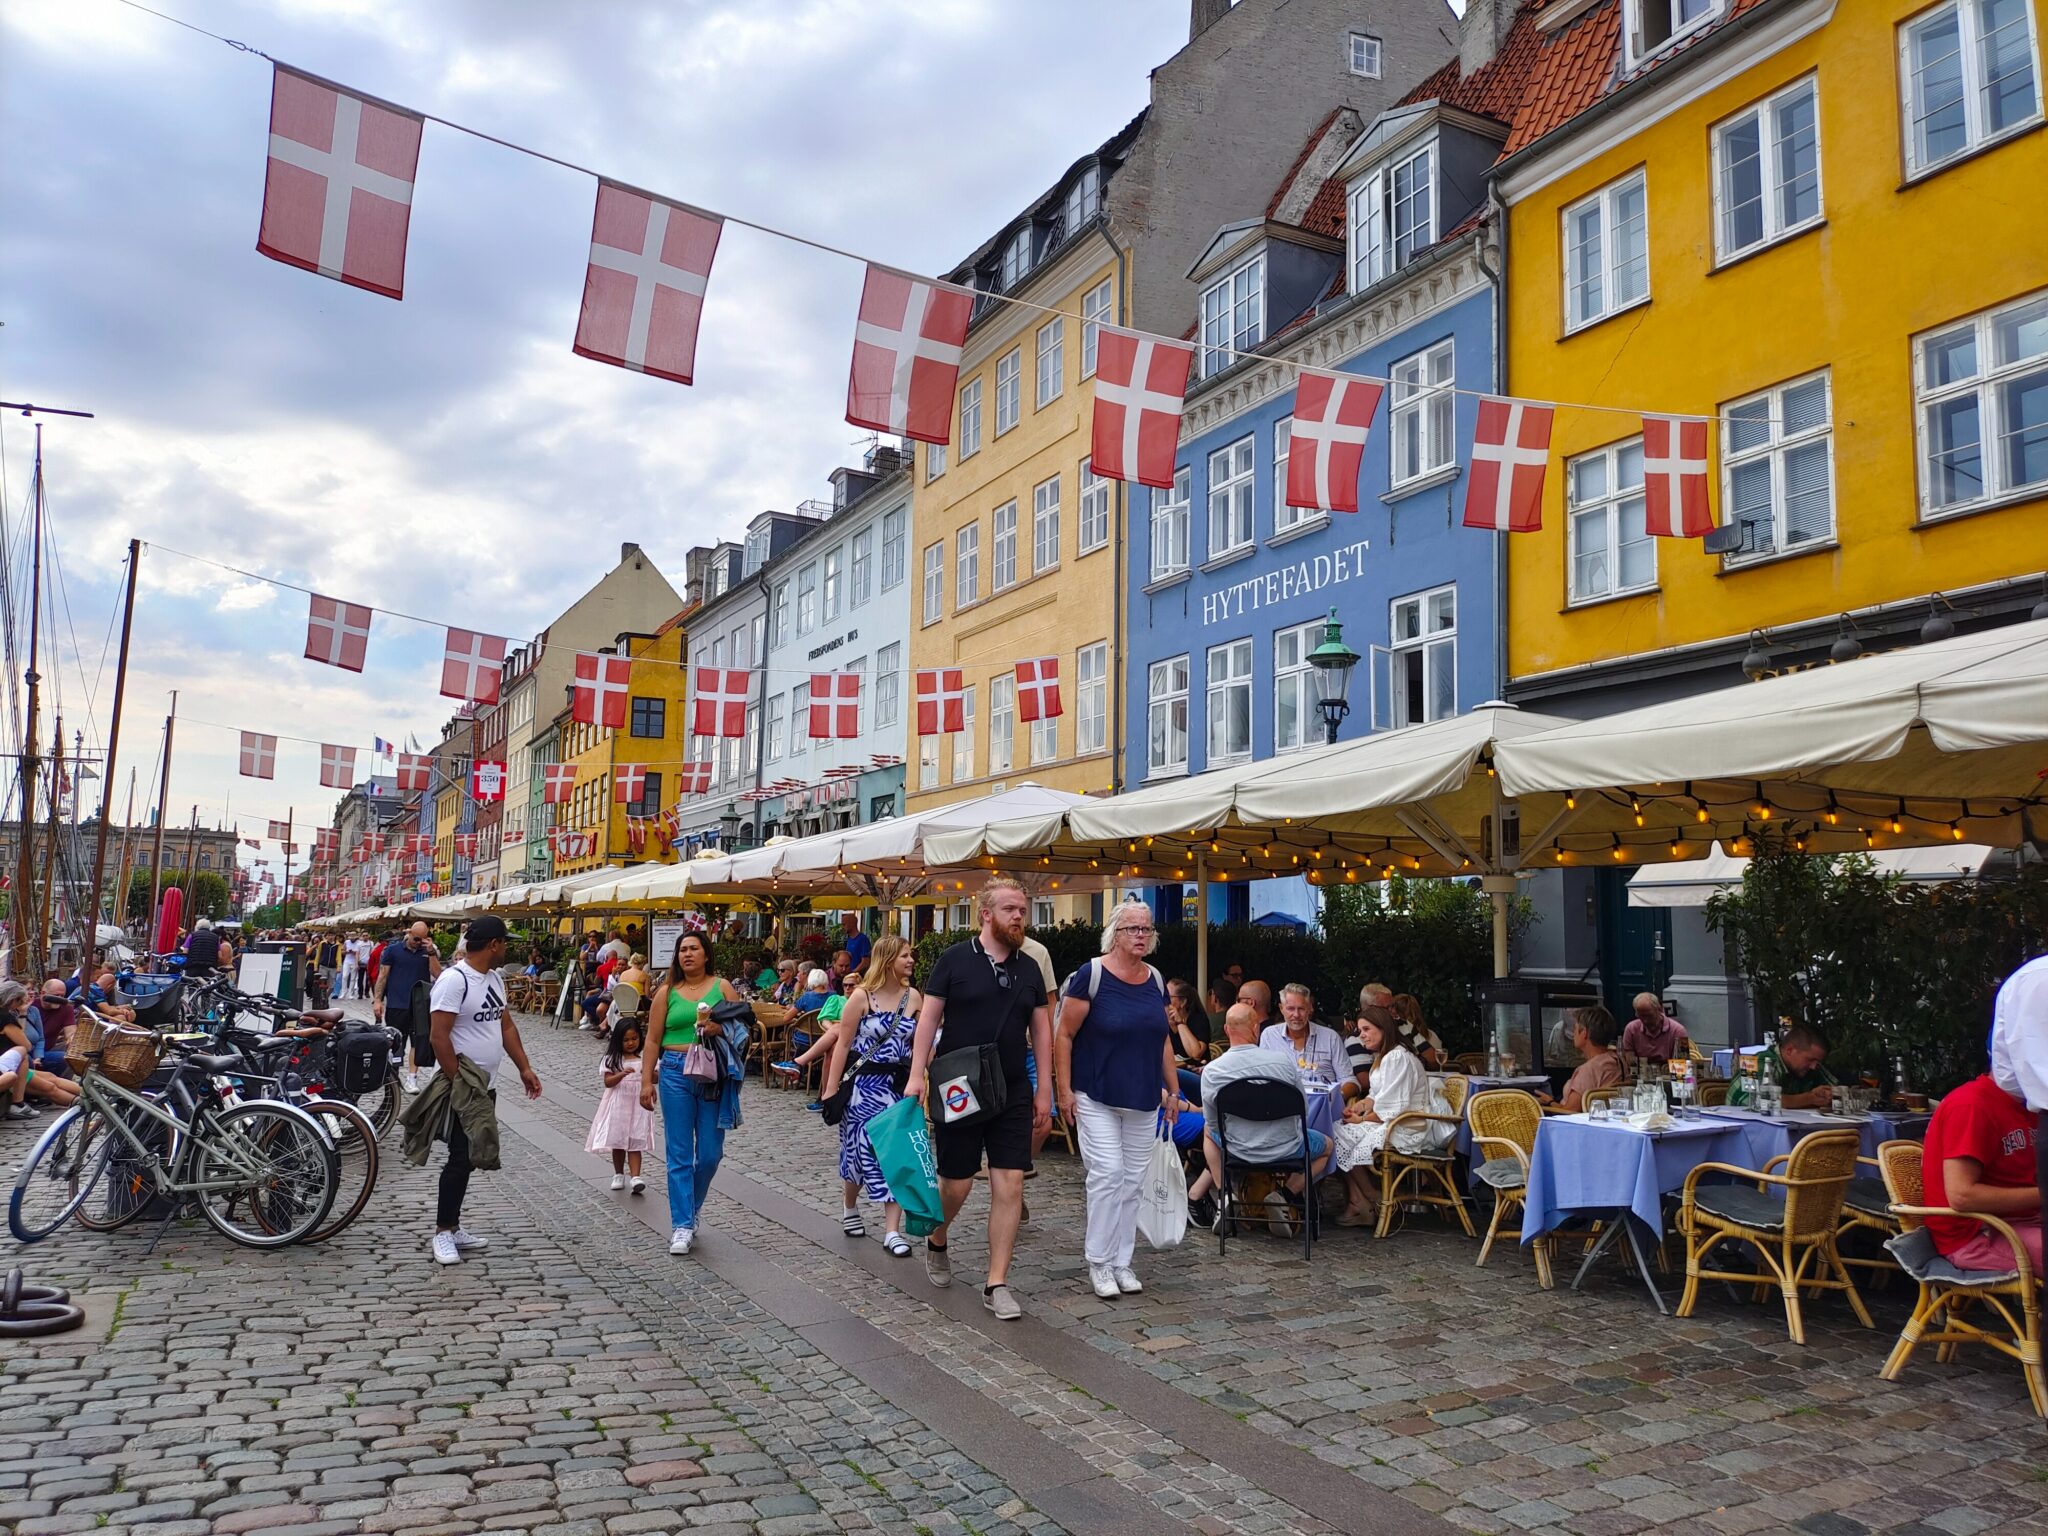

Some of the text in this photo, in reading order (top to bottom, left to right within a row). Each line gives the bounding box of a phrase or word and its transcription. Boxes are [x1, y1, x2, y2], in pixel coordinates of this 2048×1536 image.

[1203, 540, 1369, 625] HYTTEFADET
[481, 775, 499, 783] 350
[561, 834, 585, 857] 17
[473, 1008, 503, 1022] adda
